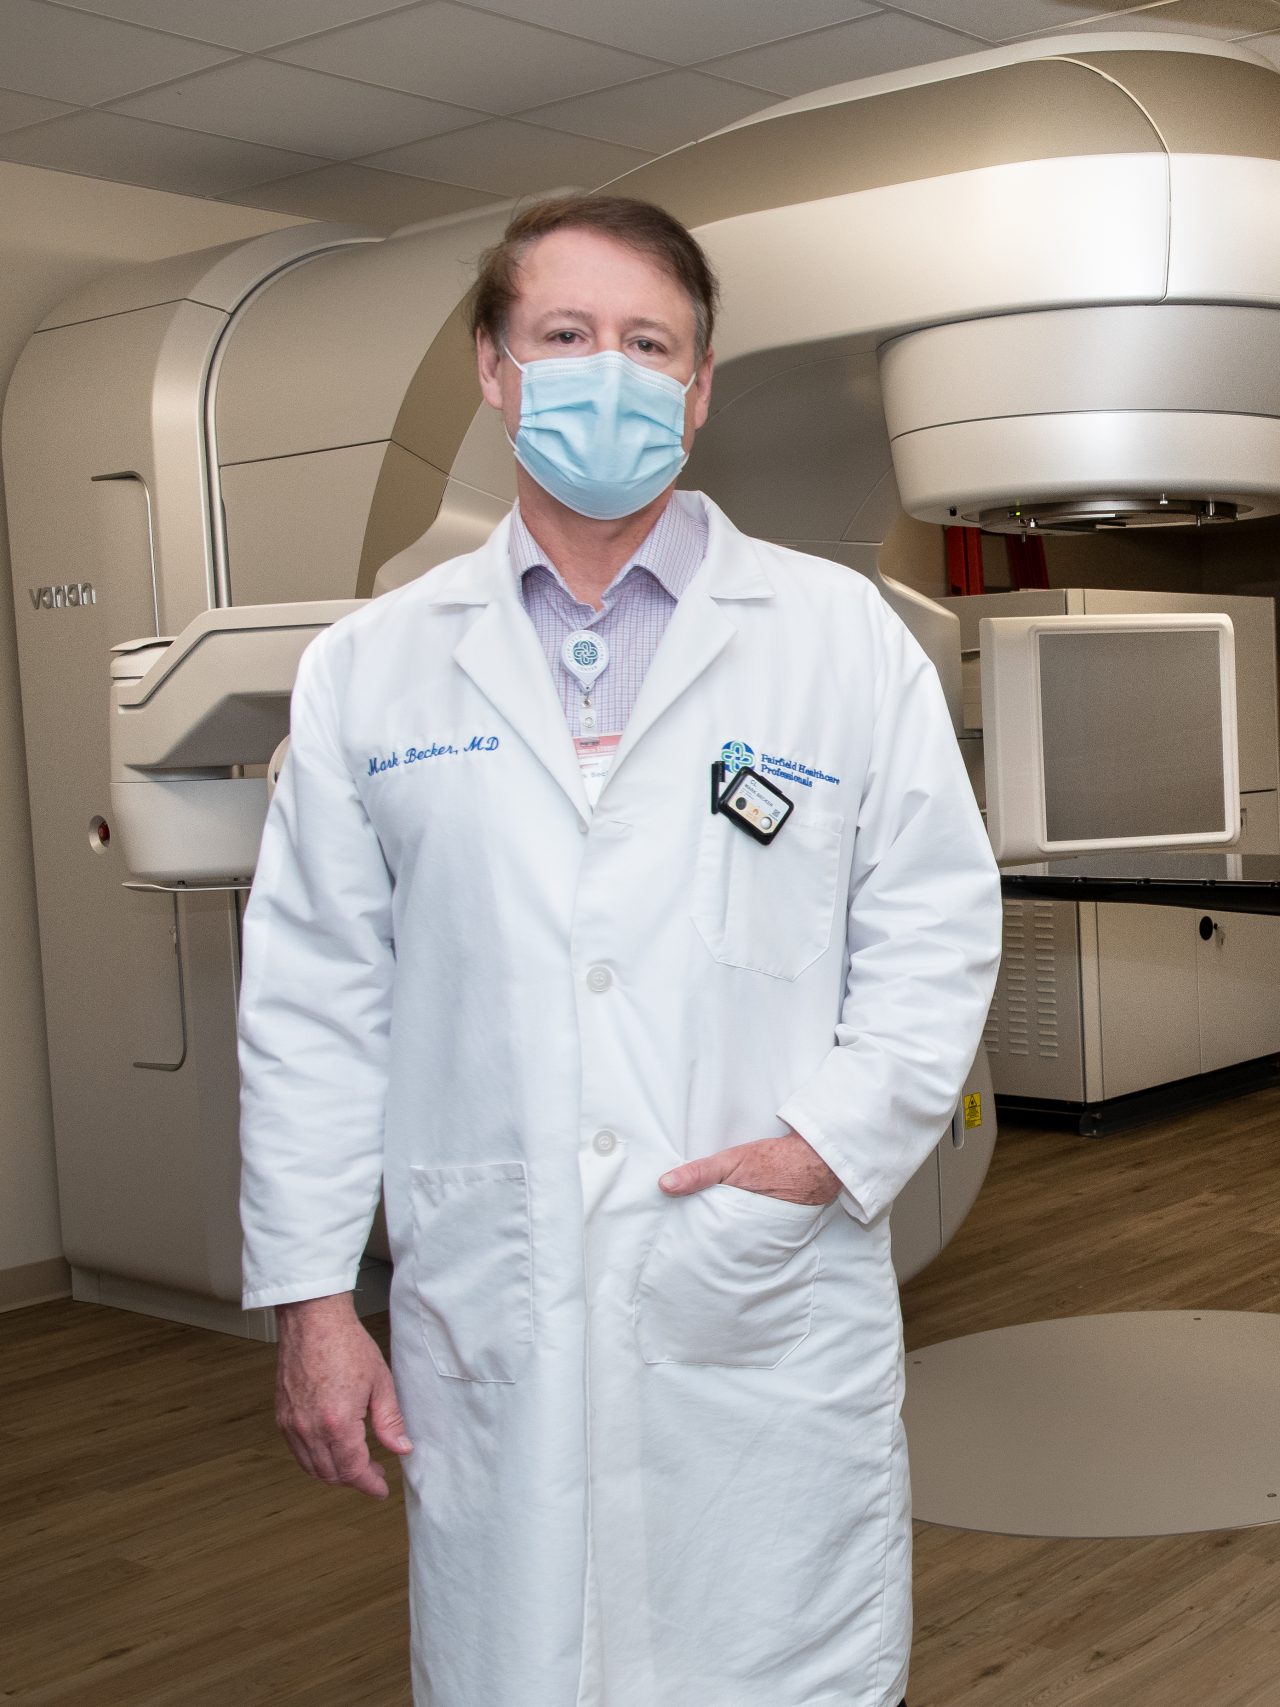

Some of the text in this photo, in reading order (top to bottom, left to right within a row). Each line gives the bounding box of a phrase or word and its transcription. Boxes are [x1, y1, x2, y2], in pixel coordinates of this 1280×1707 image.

[28, 582, 97, 610] varian
[367, 736, 499, 776] Mark Becker, MD
[761, 754, 840, 785] Fairfield Healthcare
[761, 763, 813, 788] Professionals
